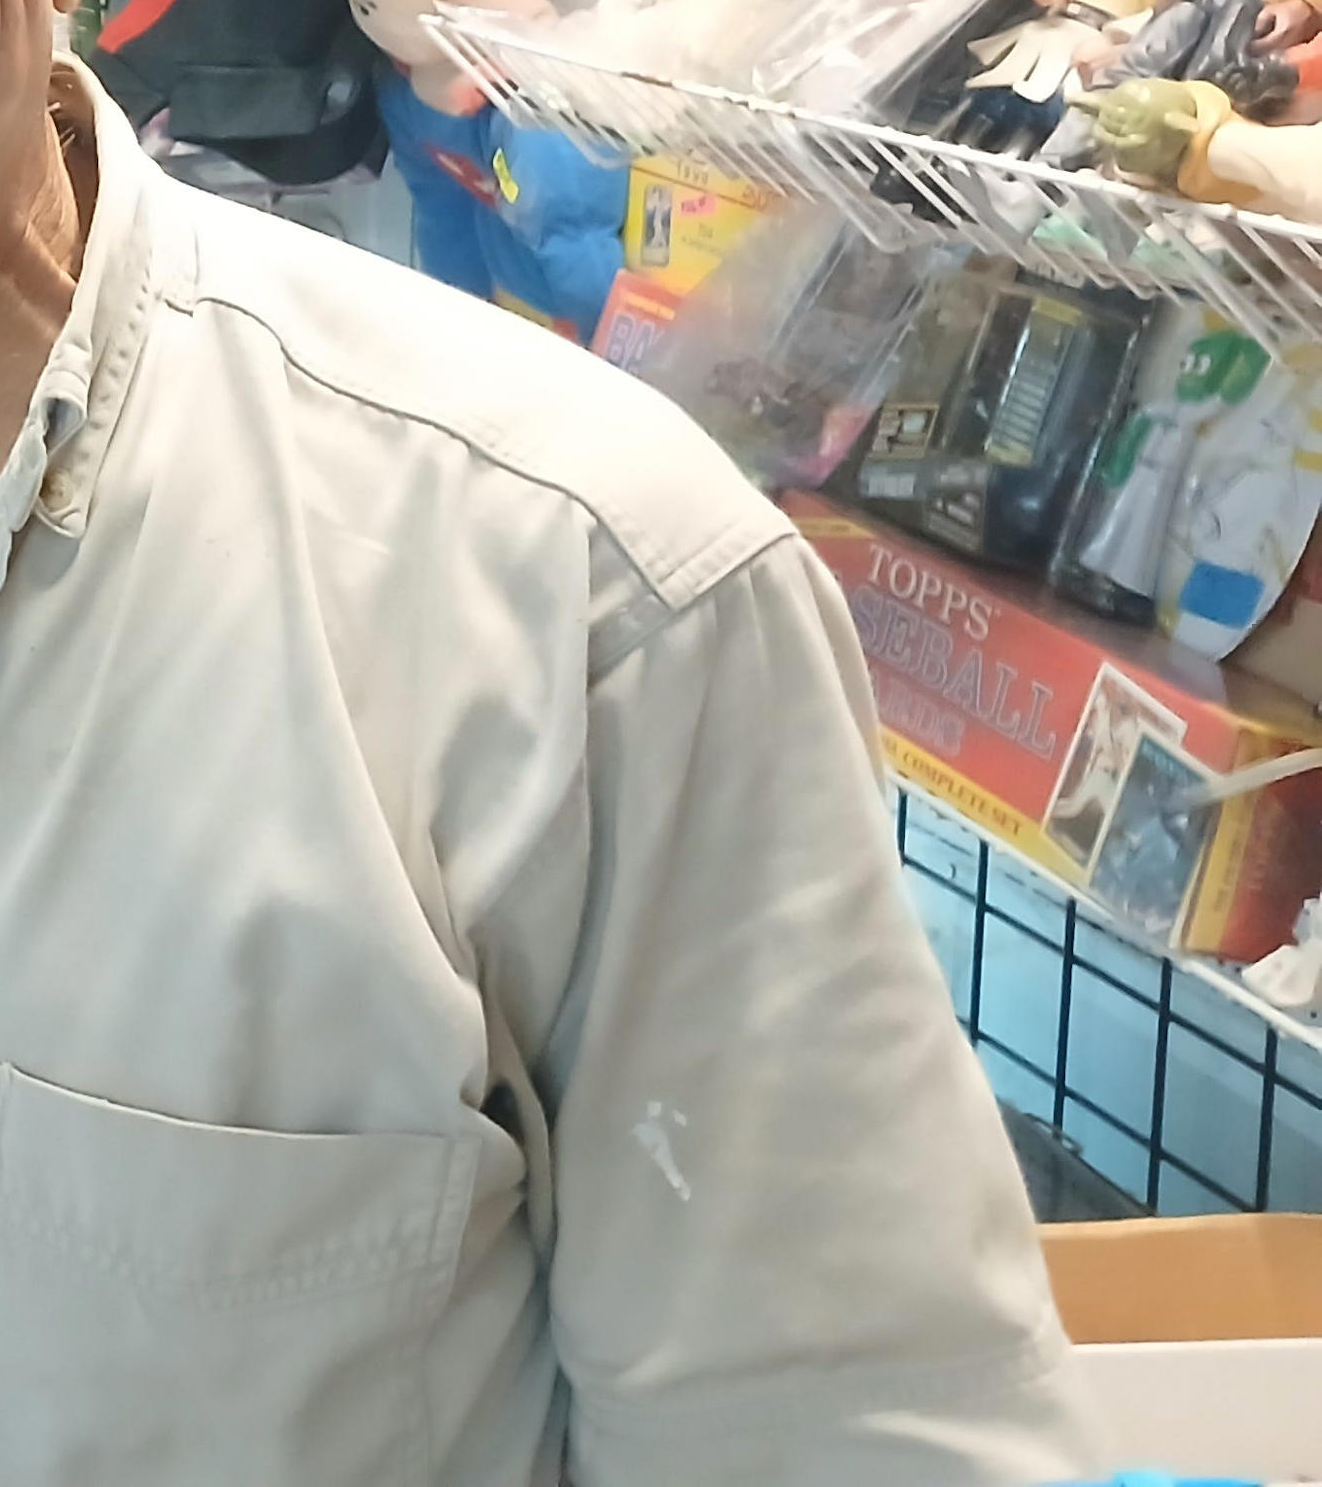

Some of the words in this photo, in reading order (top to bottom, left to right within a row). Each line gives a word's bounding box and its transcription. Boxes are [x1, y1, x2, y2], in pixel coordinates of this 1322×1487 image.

[869, 544, 995, 642] TOPPS
[851, 586, 1057, 762] SEBALL
[902, 749, 986, 810] COMPLETE
[992, 808, 1022, 838] SET
